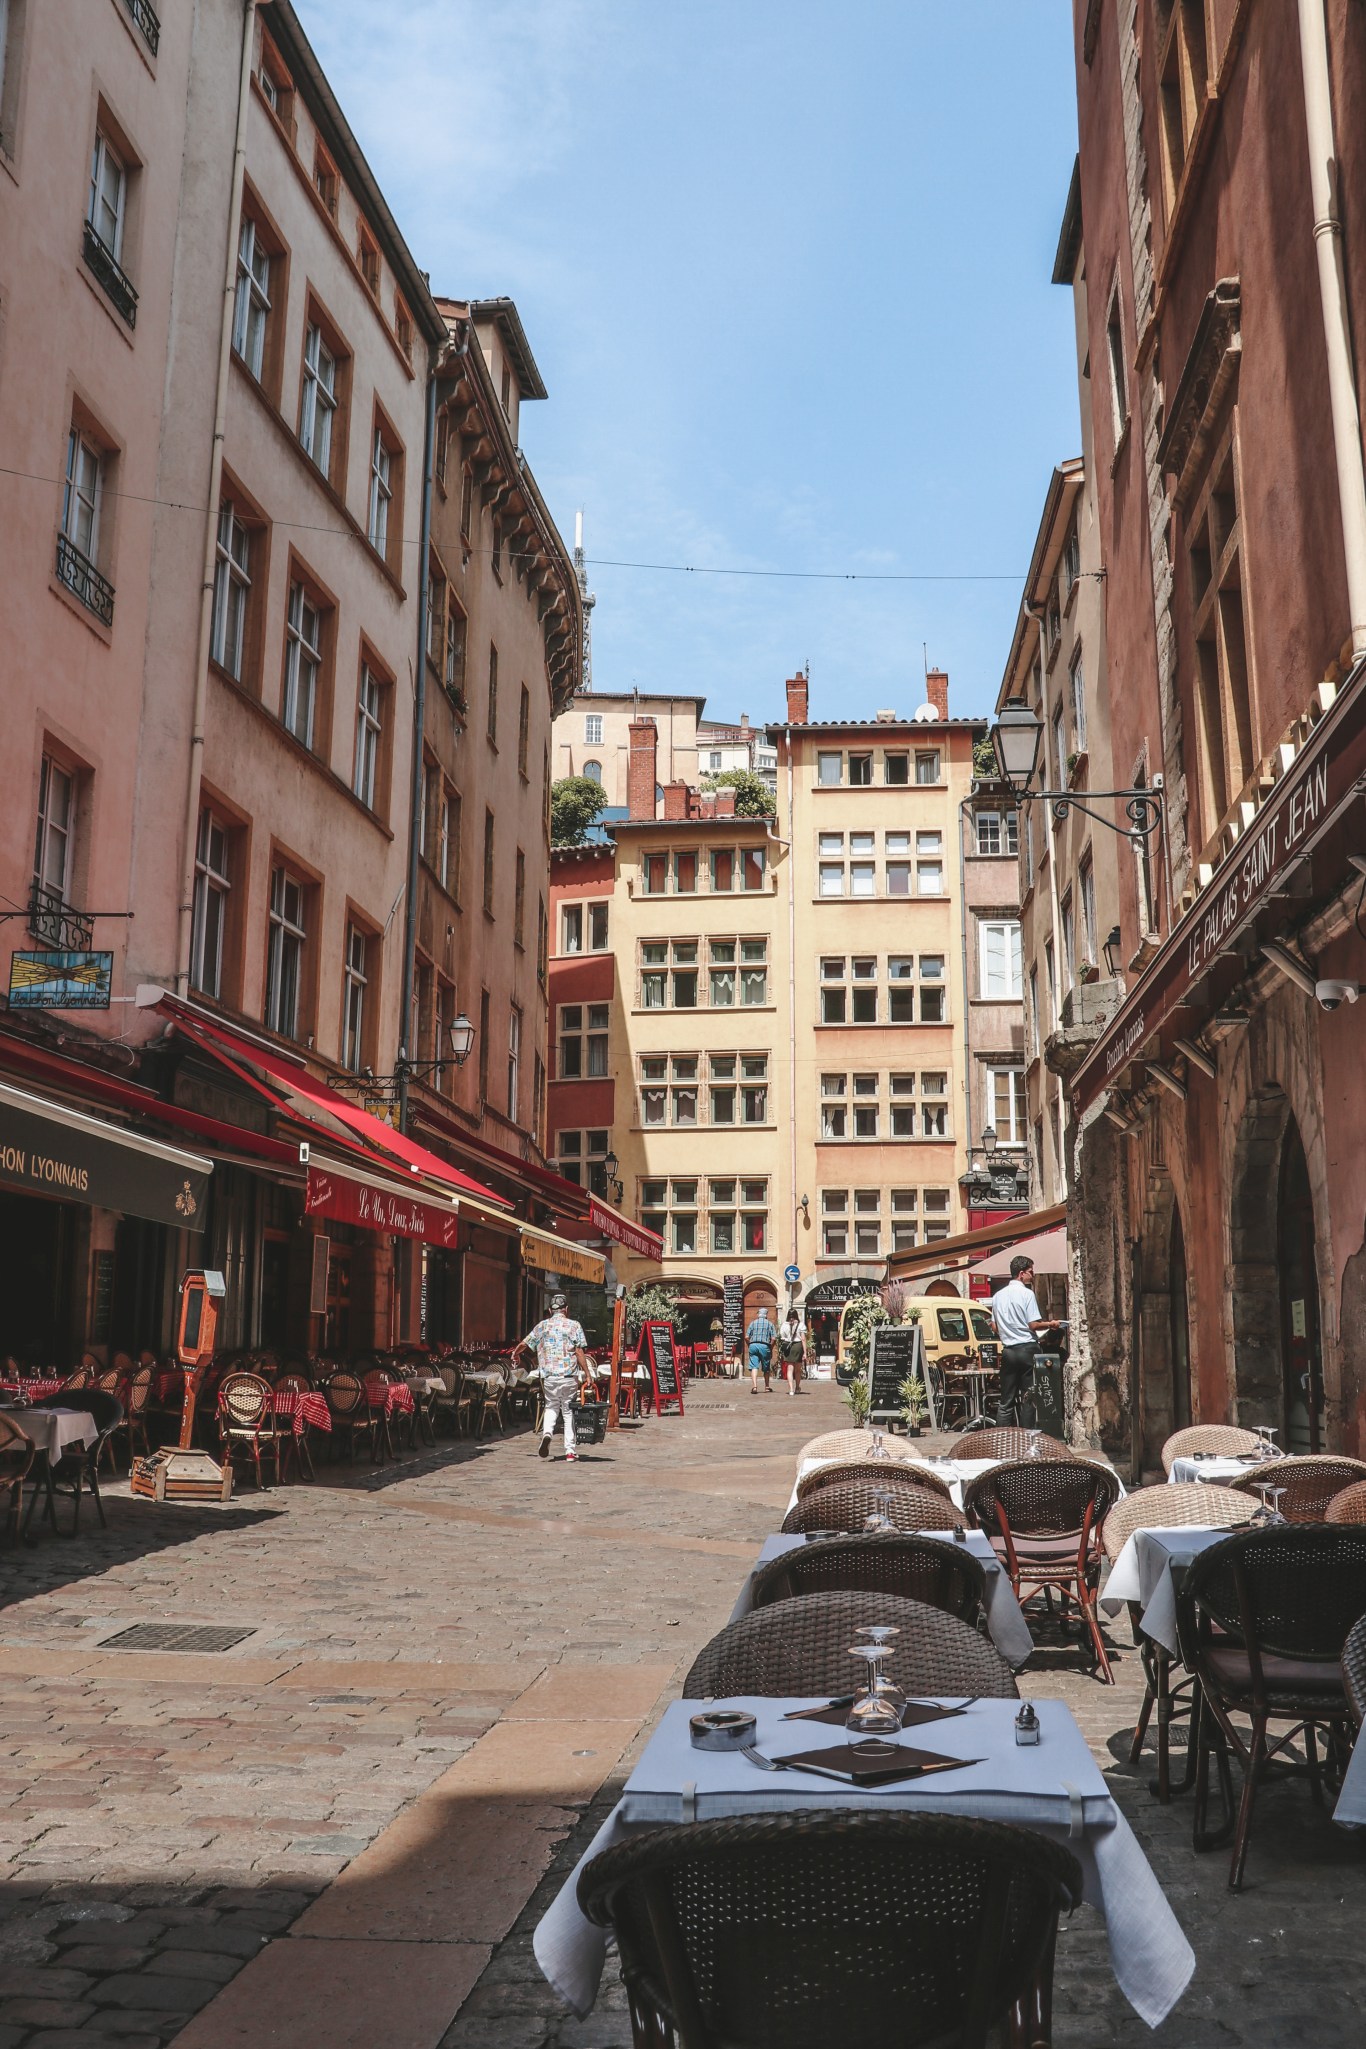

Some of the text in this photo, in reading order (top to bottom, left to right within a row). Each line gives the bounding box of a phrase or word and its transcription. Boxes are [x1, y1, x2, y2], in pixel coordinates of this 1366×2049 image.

[1189, 752, 1328, 977] LE PALAIS SAINT JEAN
[57, 992, 108, 1008] lyonnais
[31, 1154, 89, 1191] LYONNAIS
[358, 1187, 370, 1219] Le
[408, 1204, 425, 1235] Trois
[818, 1285, 881, 1295] ANTIC WIN
